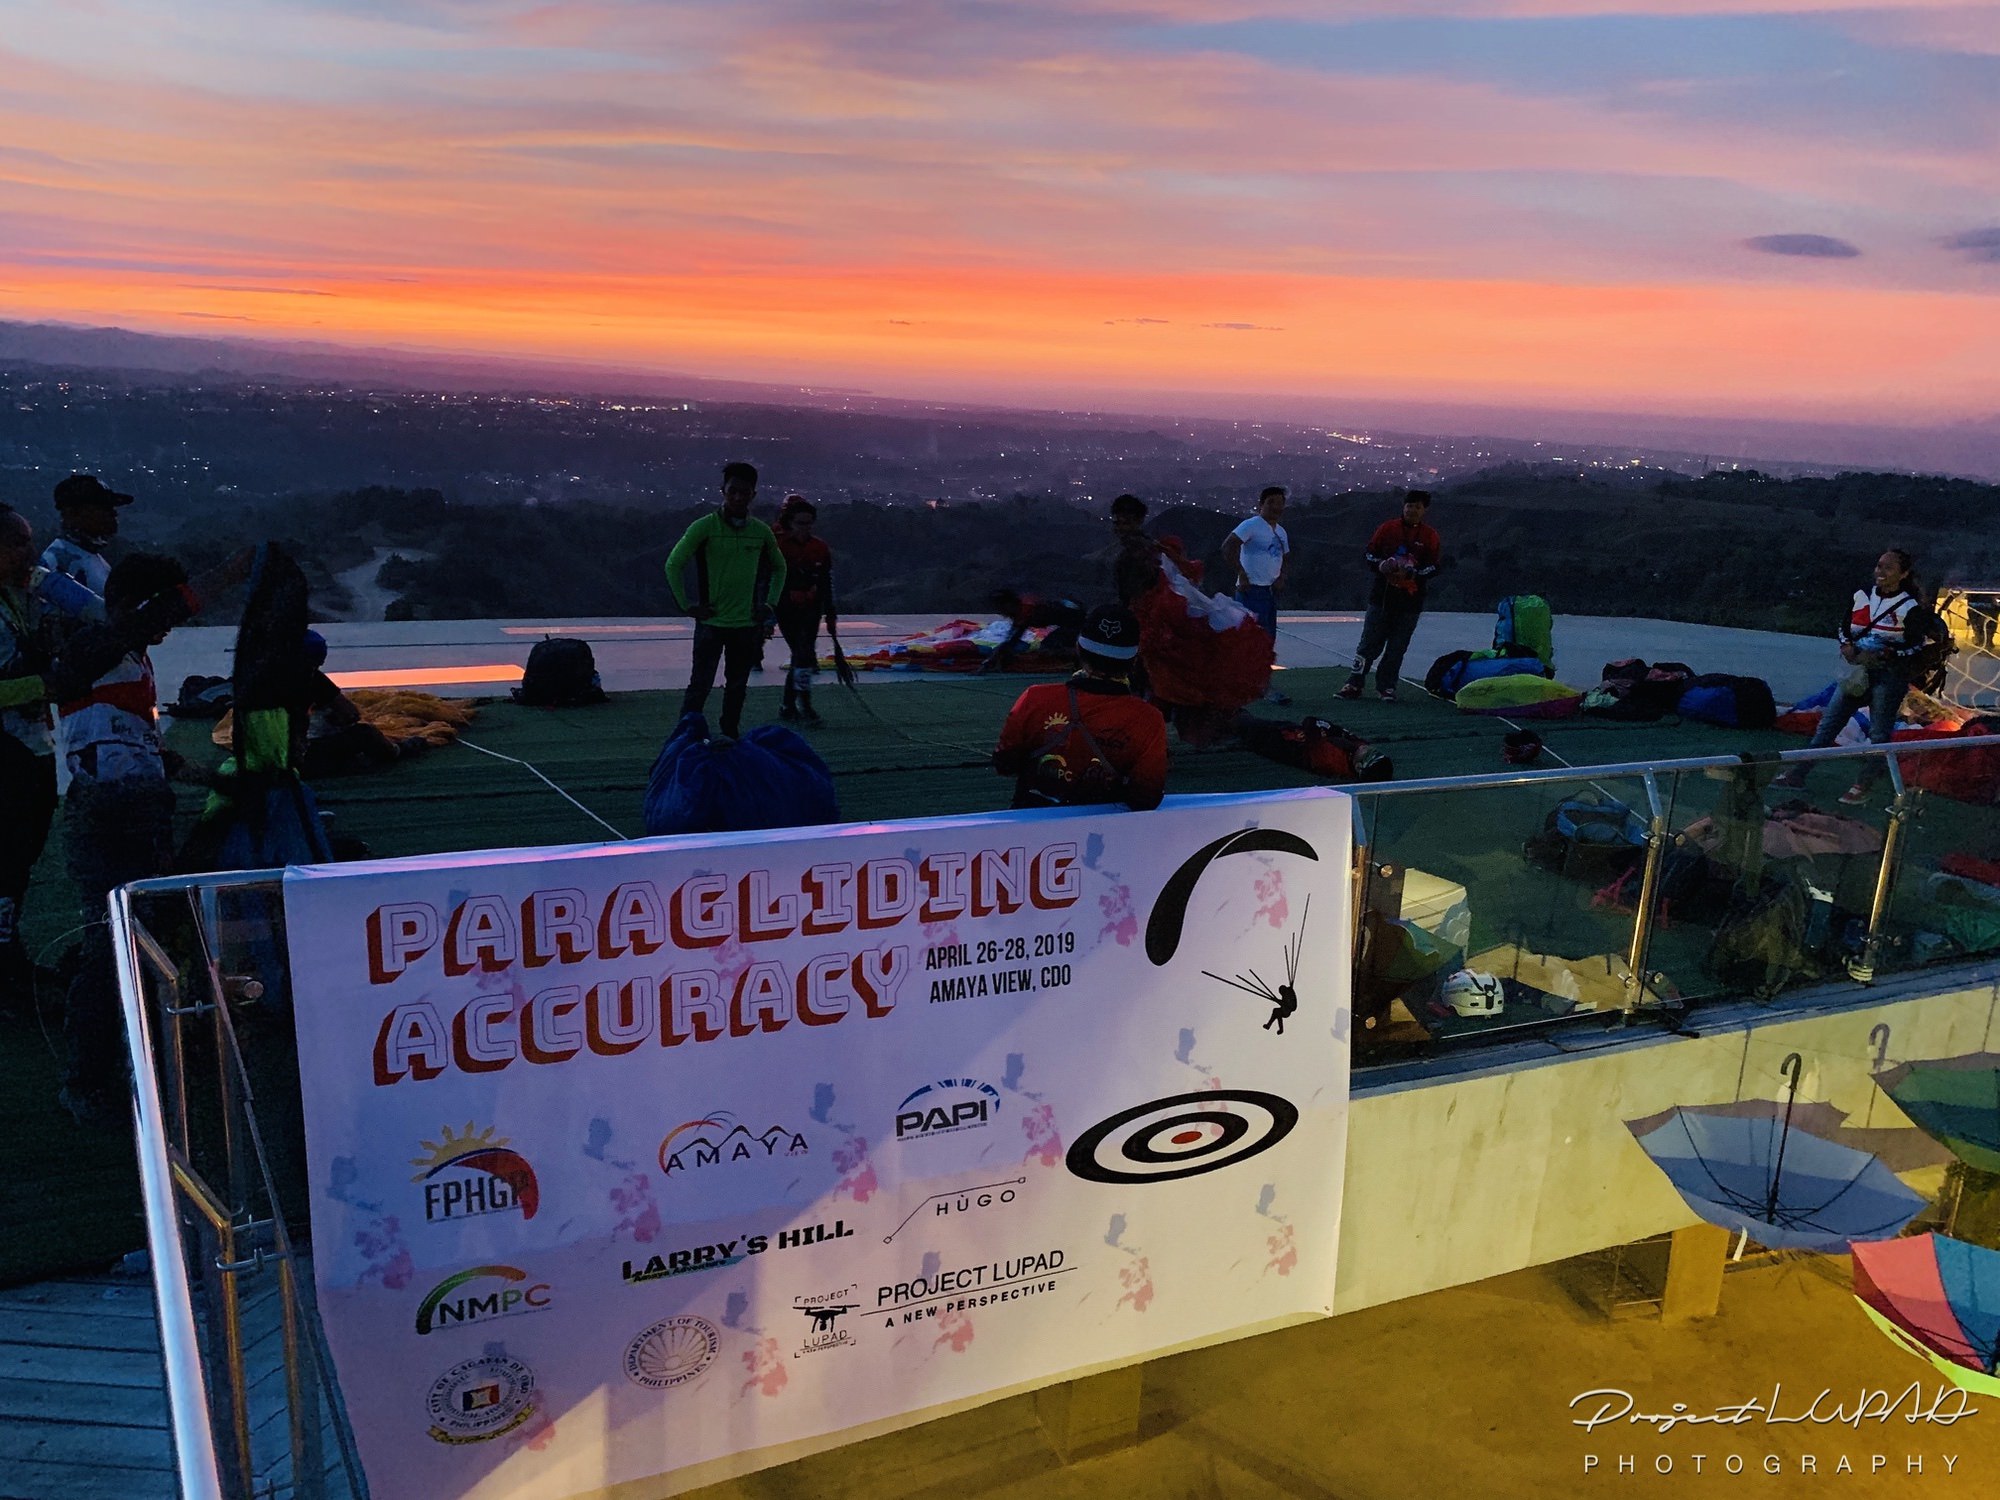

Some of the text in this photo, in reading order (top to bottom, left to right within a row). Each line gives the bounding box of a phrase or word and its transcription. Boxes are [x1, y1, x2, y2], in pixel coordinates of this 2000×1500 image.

[366, 842, 1082, 984] PARAGLIDING
[925, 931, 1076, 970] APRIL 26-28, 2019
[929, 963, 1072, 1004] AMAYA VIEW, CDO
[373, 945, 910, 1087] ACCURACY
[896, 1099, 988, 1137] PAPI
[663, 1133, 809, 1174] AMAYA
[425, 1169, 529, 1221] FPHGP
[622, 1220, 854, 1281] LARRY'S HILL
[803, 1288, 849, 1304] PROJECT
[878, 1250, 1065, 1307] PROJECT LUPAD
[439, 1284, 552, 1325] NMPC
[885, 1280, 1057, 1329] A NEW PERSPECTIVE
[694, 1320, 717, 1354] TOURISM
[803, 1329, 848, 1348] LUPAD
